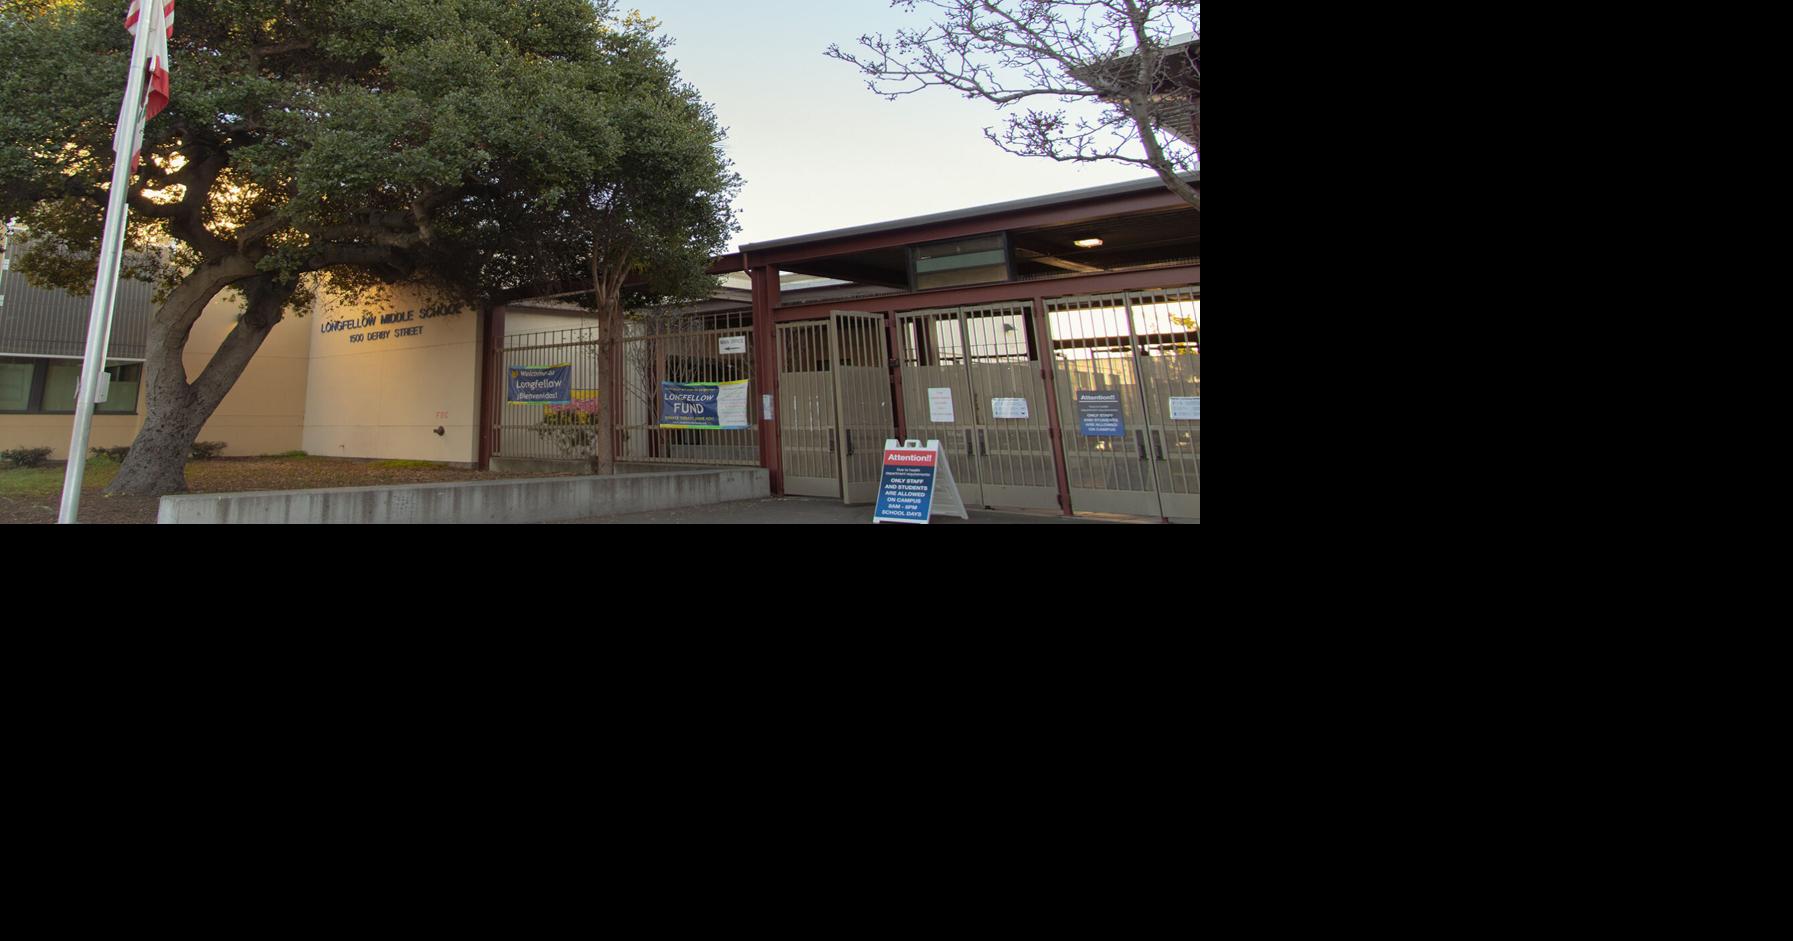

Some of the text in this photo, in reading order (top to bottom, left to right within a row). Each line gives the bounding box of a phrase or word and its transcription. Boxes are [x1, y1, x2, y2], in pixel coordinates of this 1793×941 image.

[321, 302, 462, 333] LONGFELLOW MIDDLE SCHOOL
[350, 326, 424, 343] 1500 DERBY STREET
[516, 379, 561, 390] Longfellow
[674, 402, 704, 414] FUND
[888, 454, 932, 462] Attention!!
